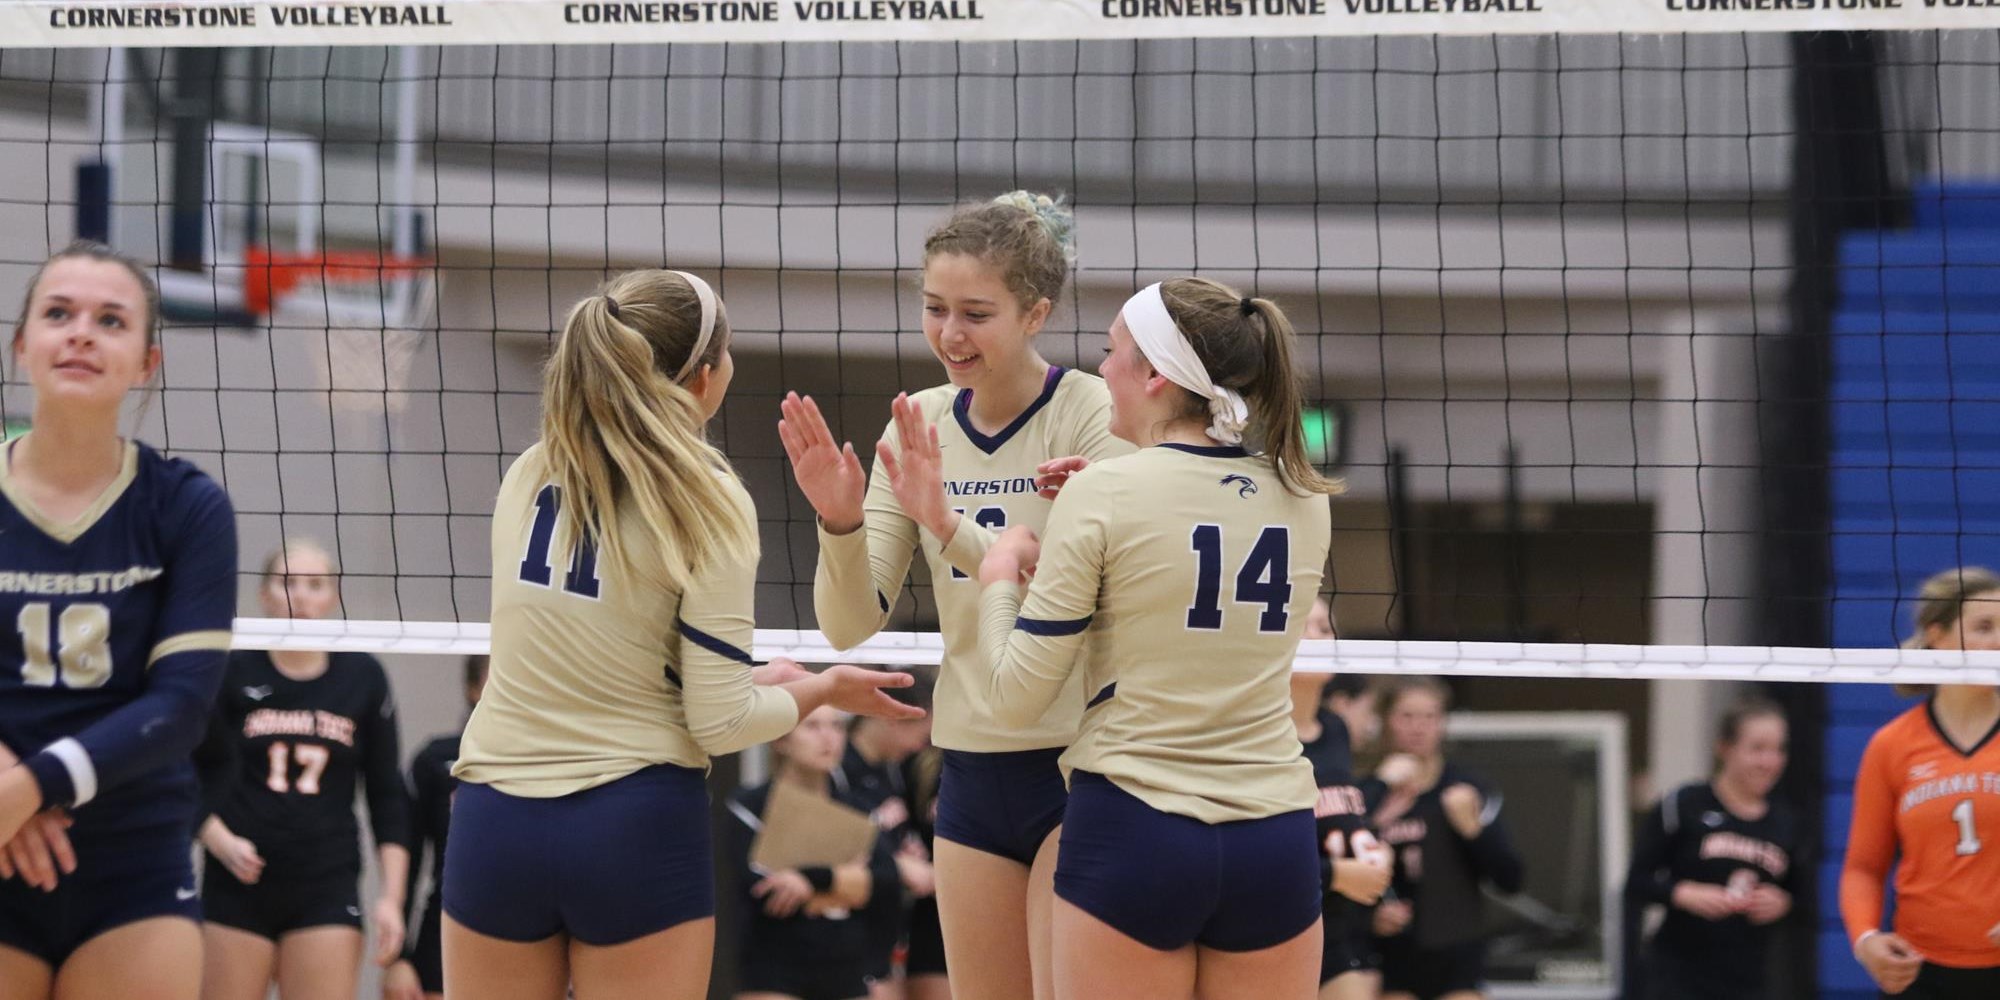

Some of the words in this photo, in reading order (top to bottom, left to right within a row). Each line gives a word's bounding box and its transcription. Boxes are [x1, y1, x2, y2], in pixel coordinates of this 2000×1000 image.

[49, 7, 257, 28] CORNERSTONE
[270, 6, 452, 26] VOLLEYBALL
[564, 2, 778, 23] CORNERSTONE
[795, 0, 984, 20] VOLLEYBALL
[1101, 0, 1326, 18] CORNERSTONE
[517, 483, 602, 601] 11
[1185, 523, 1292, 635] 14
[17, 602, 113, 689] 18
[266, 741, 330, 794] 17
[1952, 799, 1981, 856] 1
